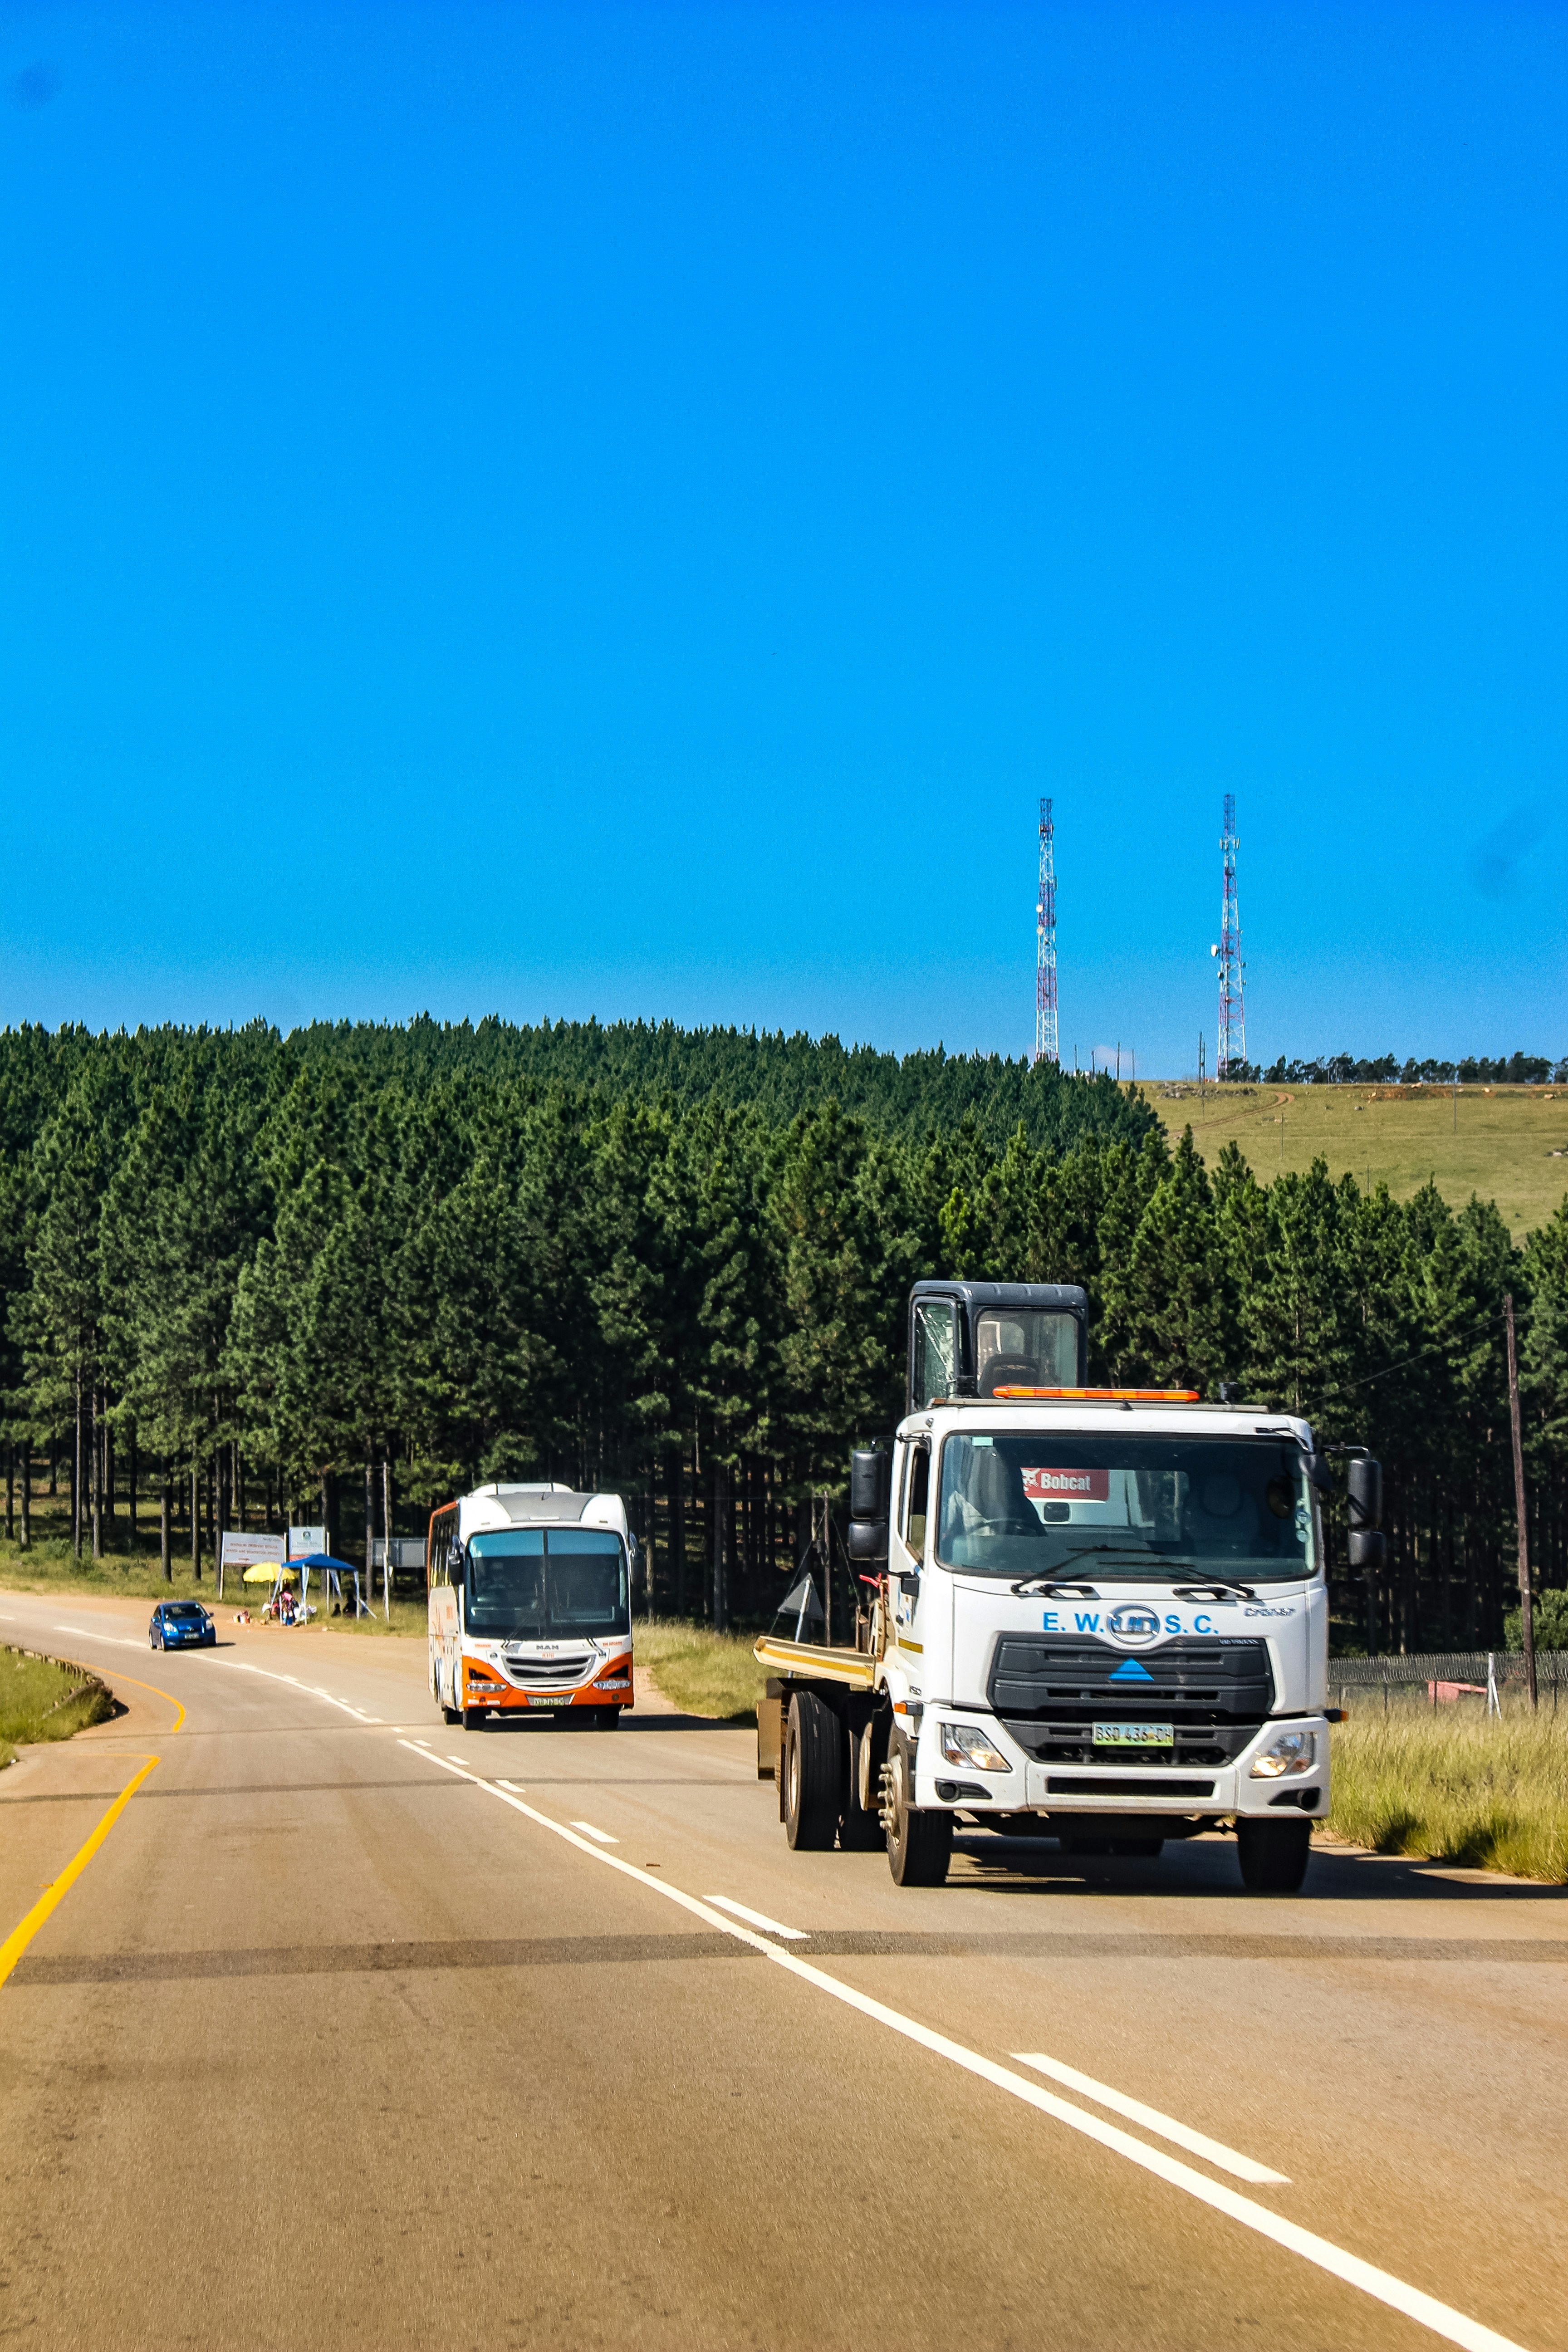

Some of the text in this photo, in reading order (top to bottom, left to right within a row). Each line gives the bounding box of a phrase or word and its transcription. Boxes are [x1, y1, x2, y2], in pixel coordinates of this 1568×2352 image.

[1041, 1473, 1091, 1491] Bobcat
[1044, 1612, 1219, 1634] E. W. S. C.
